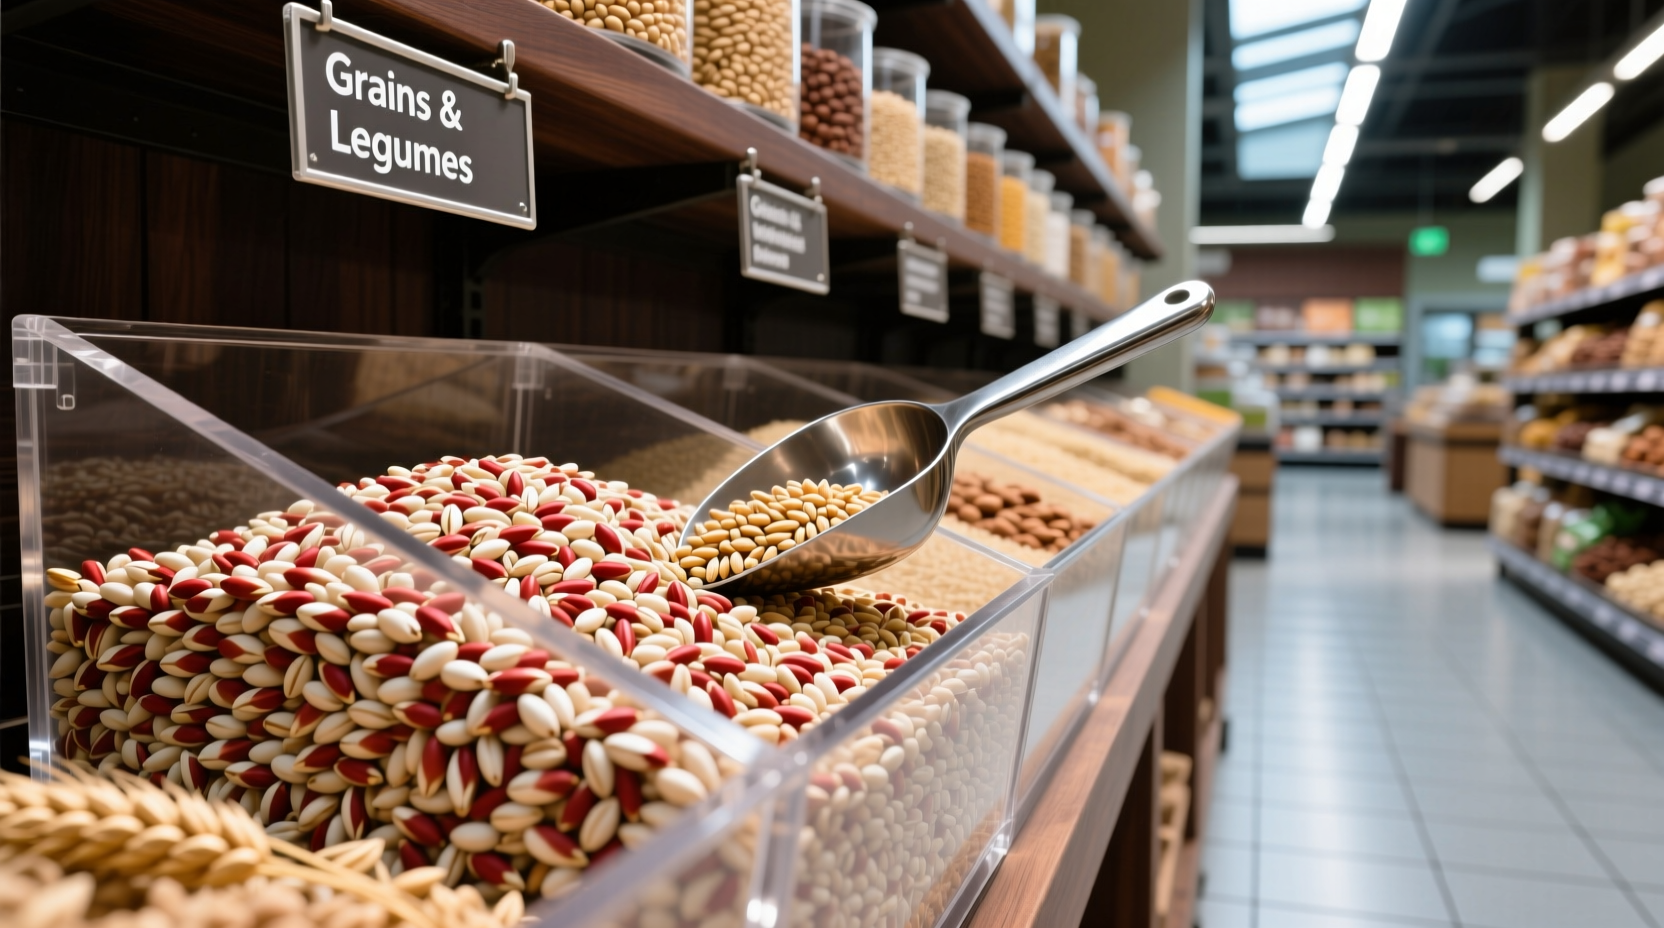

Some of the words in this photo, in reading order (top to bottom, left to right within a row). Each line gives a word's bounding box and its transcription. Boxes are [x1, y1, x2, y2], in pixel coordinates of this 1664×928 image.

[325, 52, 431, 121] Grains
[439, 90, 463, 131] &
[330, 109, 473, 184] Legumes
